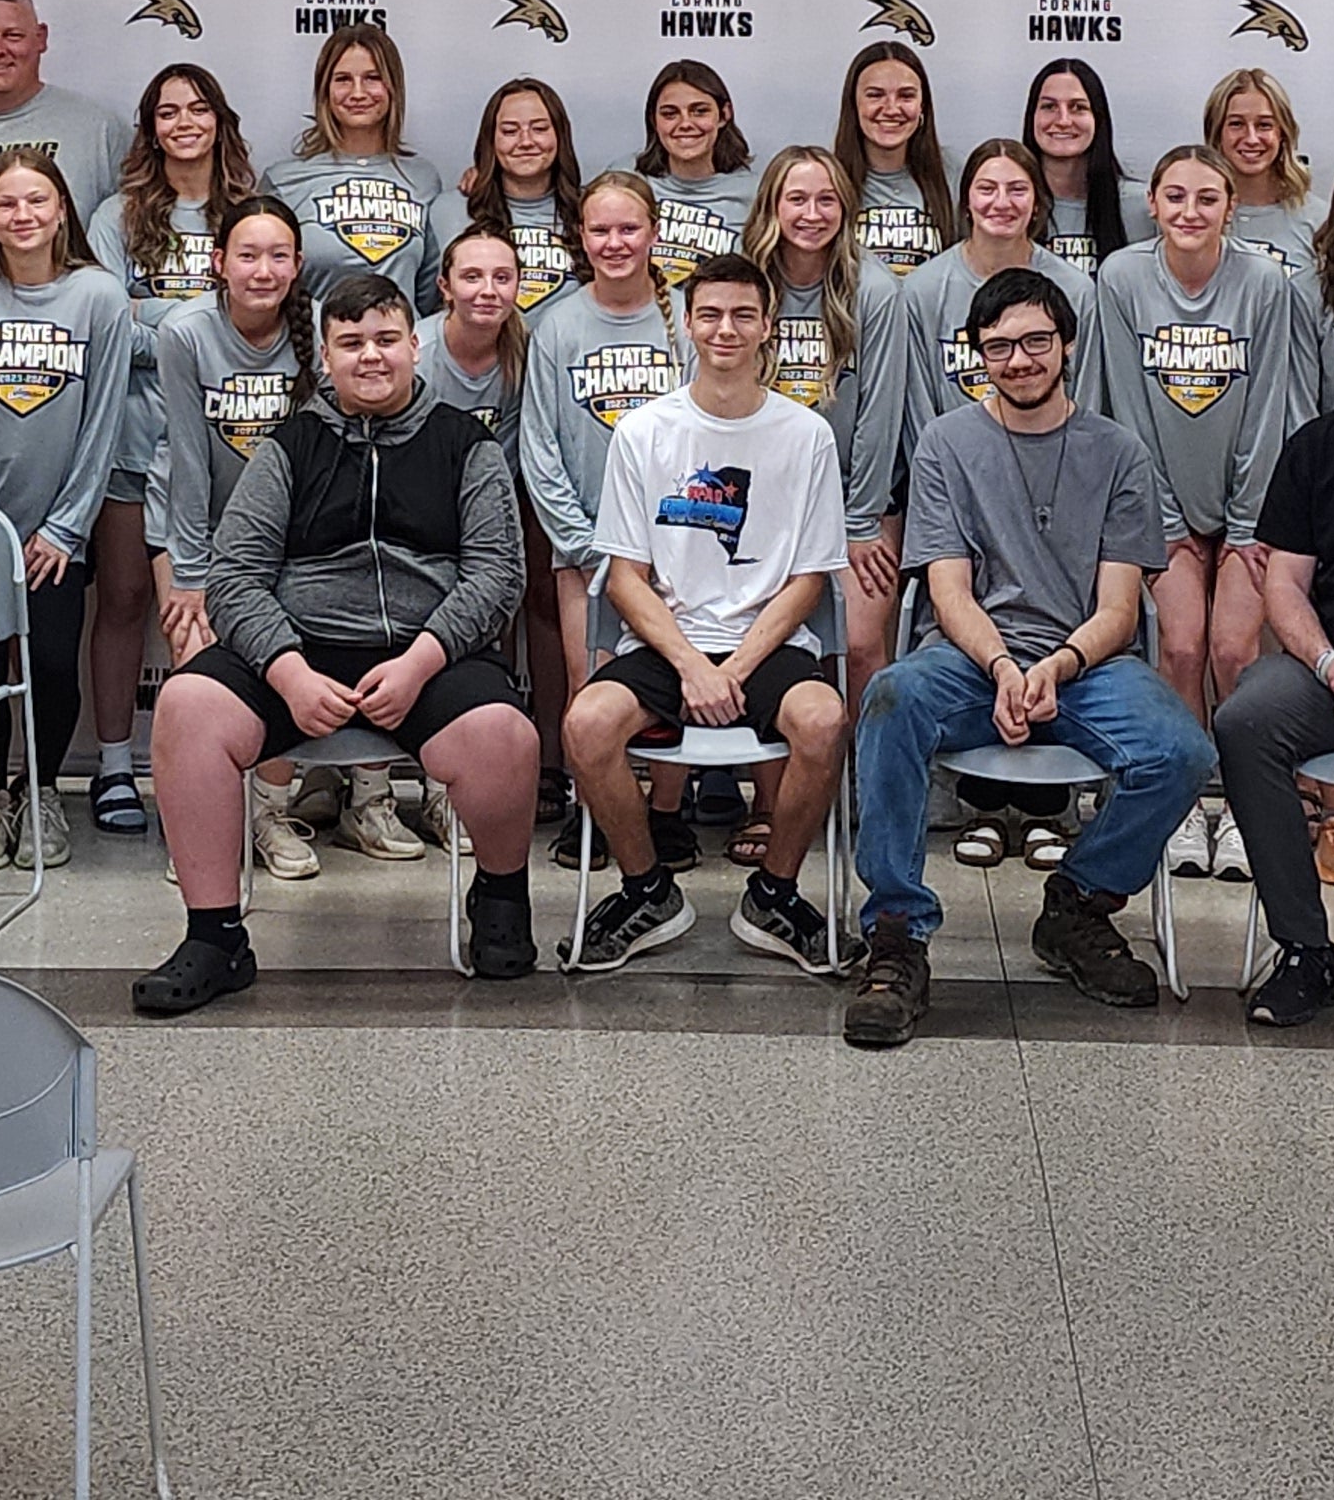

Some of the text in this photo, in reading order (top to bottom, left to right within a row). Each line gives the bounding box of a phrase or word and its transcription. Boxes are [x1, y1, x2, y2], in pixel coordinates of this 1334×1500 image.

[661, 10, 753, 37] HAWKS
[1029, 14, 1122, 42] HAWKS
[348, 180, 395, 199] STATE
[317, 197, 423, 231] CHAMPION
[659, 200, 708, 224] STATE
[868, 208, 917, 226] STATE
[513, 228, 549, 245] TATE
[658, 218, 736, 255] AMPION
[854, 224, 943, 254] HAMPION
[1, 322, 53, 343] STATE
[779, 320, 824, 339] STATE
[1171, 325, 1217, 345] STATE
[601, 346, 652, 367] STATE
[1142, 337, 1247, 372] CHAMPION
[234, 374, 284, 394] STATE
[205, 389, 290, 420] CHAMPI
